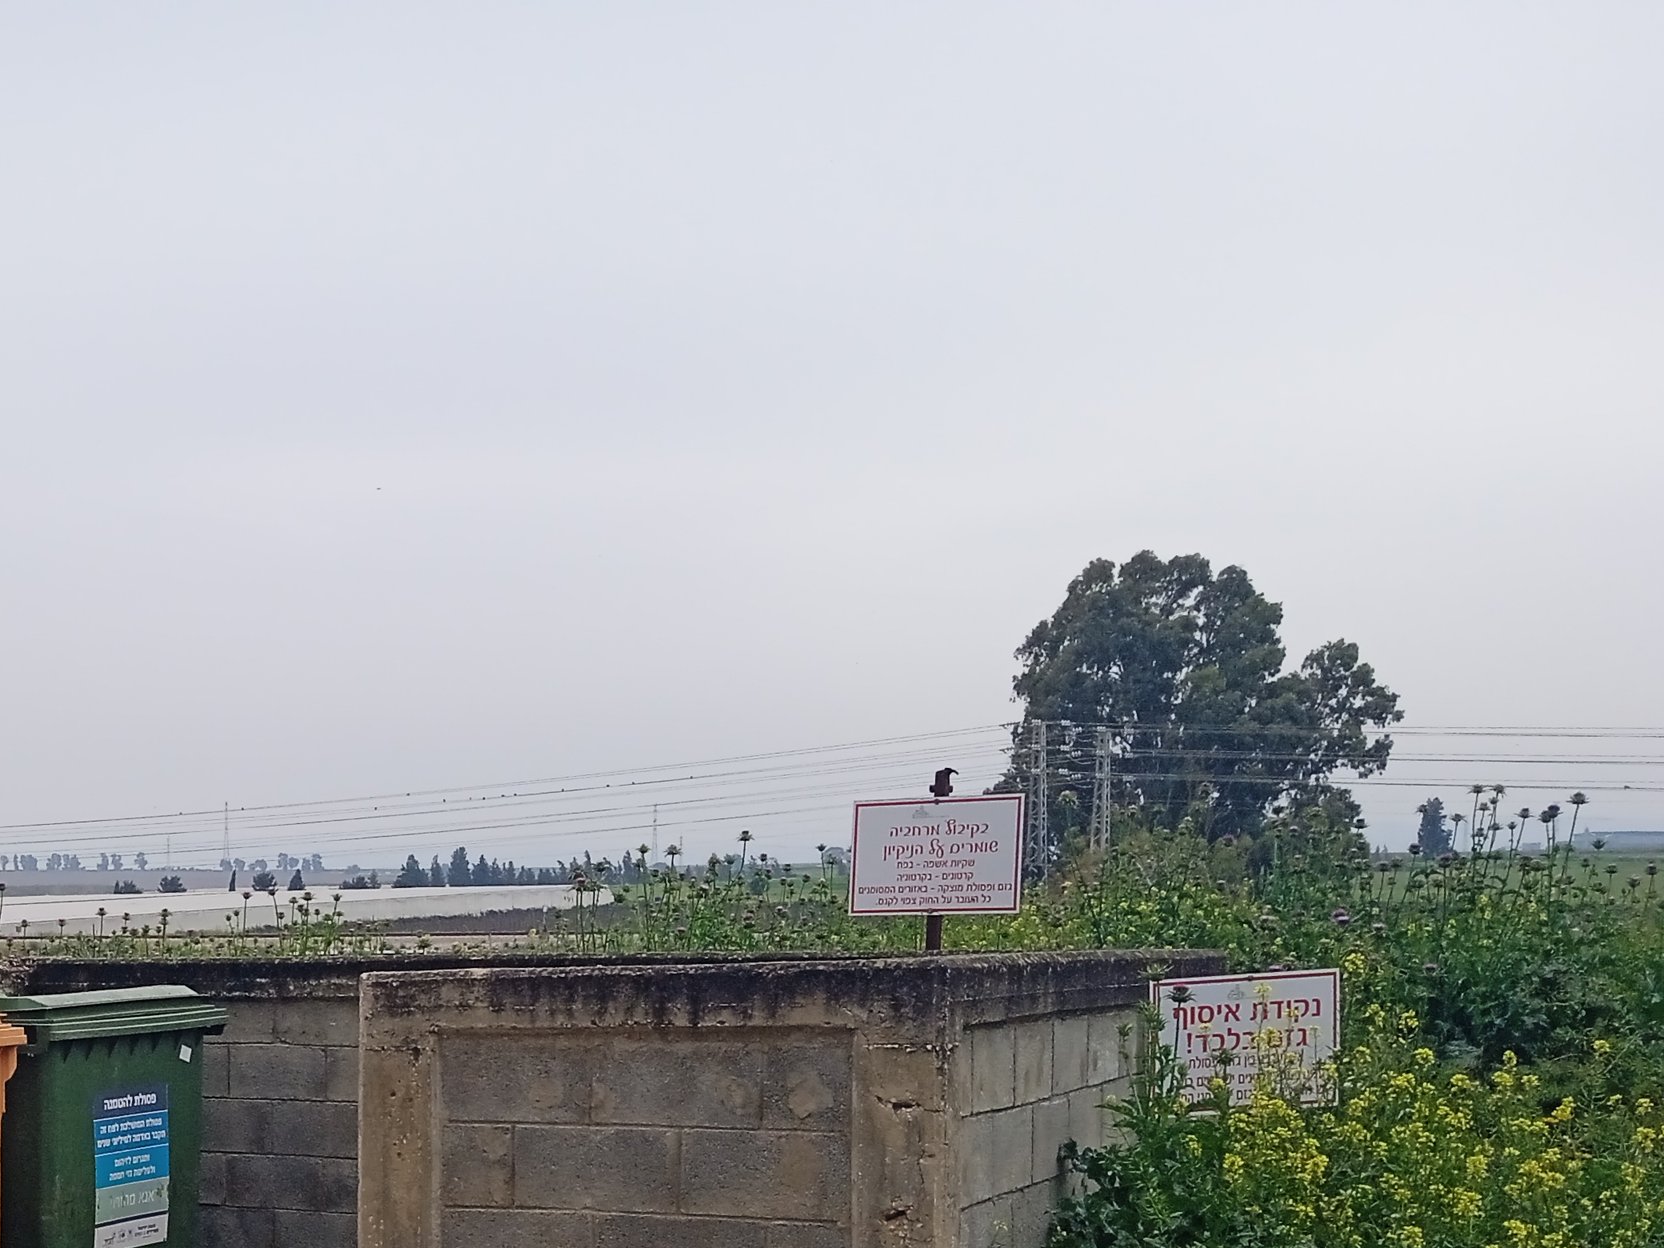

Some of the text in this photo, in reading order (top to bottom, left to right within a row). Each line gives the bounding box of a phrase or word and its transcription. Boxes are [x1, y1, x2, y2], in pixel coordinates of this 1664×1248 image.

[889, 823, 941, 838] מרחביה
[883, 838, 999, 861] שומרים על הניקיון
[896, 861, 914, 869] בפח
[922, 860, 948, 869] אשפה
[950, 859, 975, 869] שקיות
[896, 873, 932, 882] בקרטוניה
[941, 871, 974, 881] קרטונים
[898, 885, 928, 894] באזורים
[937, 884, 964, 894] מוצקה
[966, 882, 995, 892] ופסולת
[997, 883, 1013, 891] גזם
[918, 896, 939, 906] החוק
[941, 894, 953, 904] על
[981, 894, 992, 903] כל
[1172, 997, 1321, 1030] נקודת איסוף
[103, 1092, 156, 1111] פסולת להטמנה
